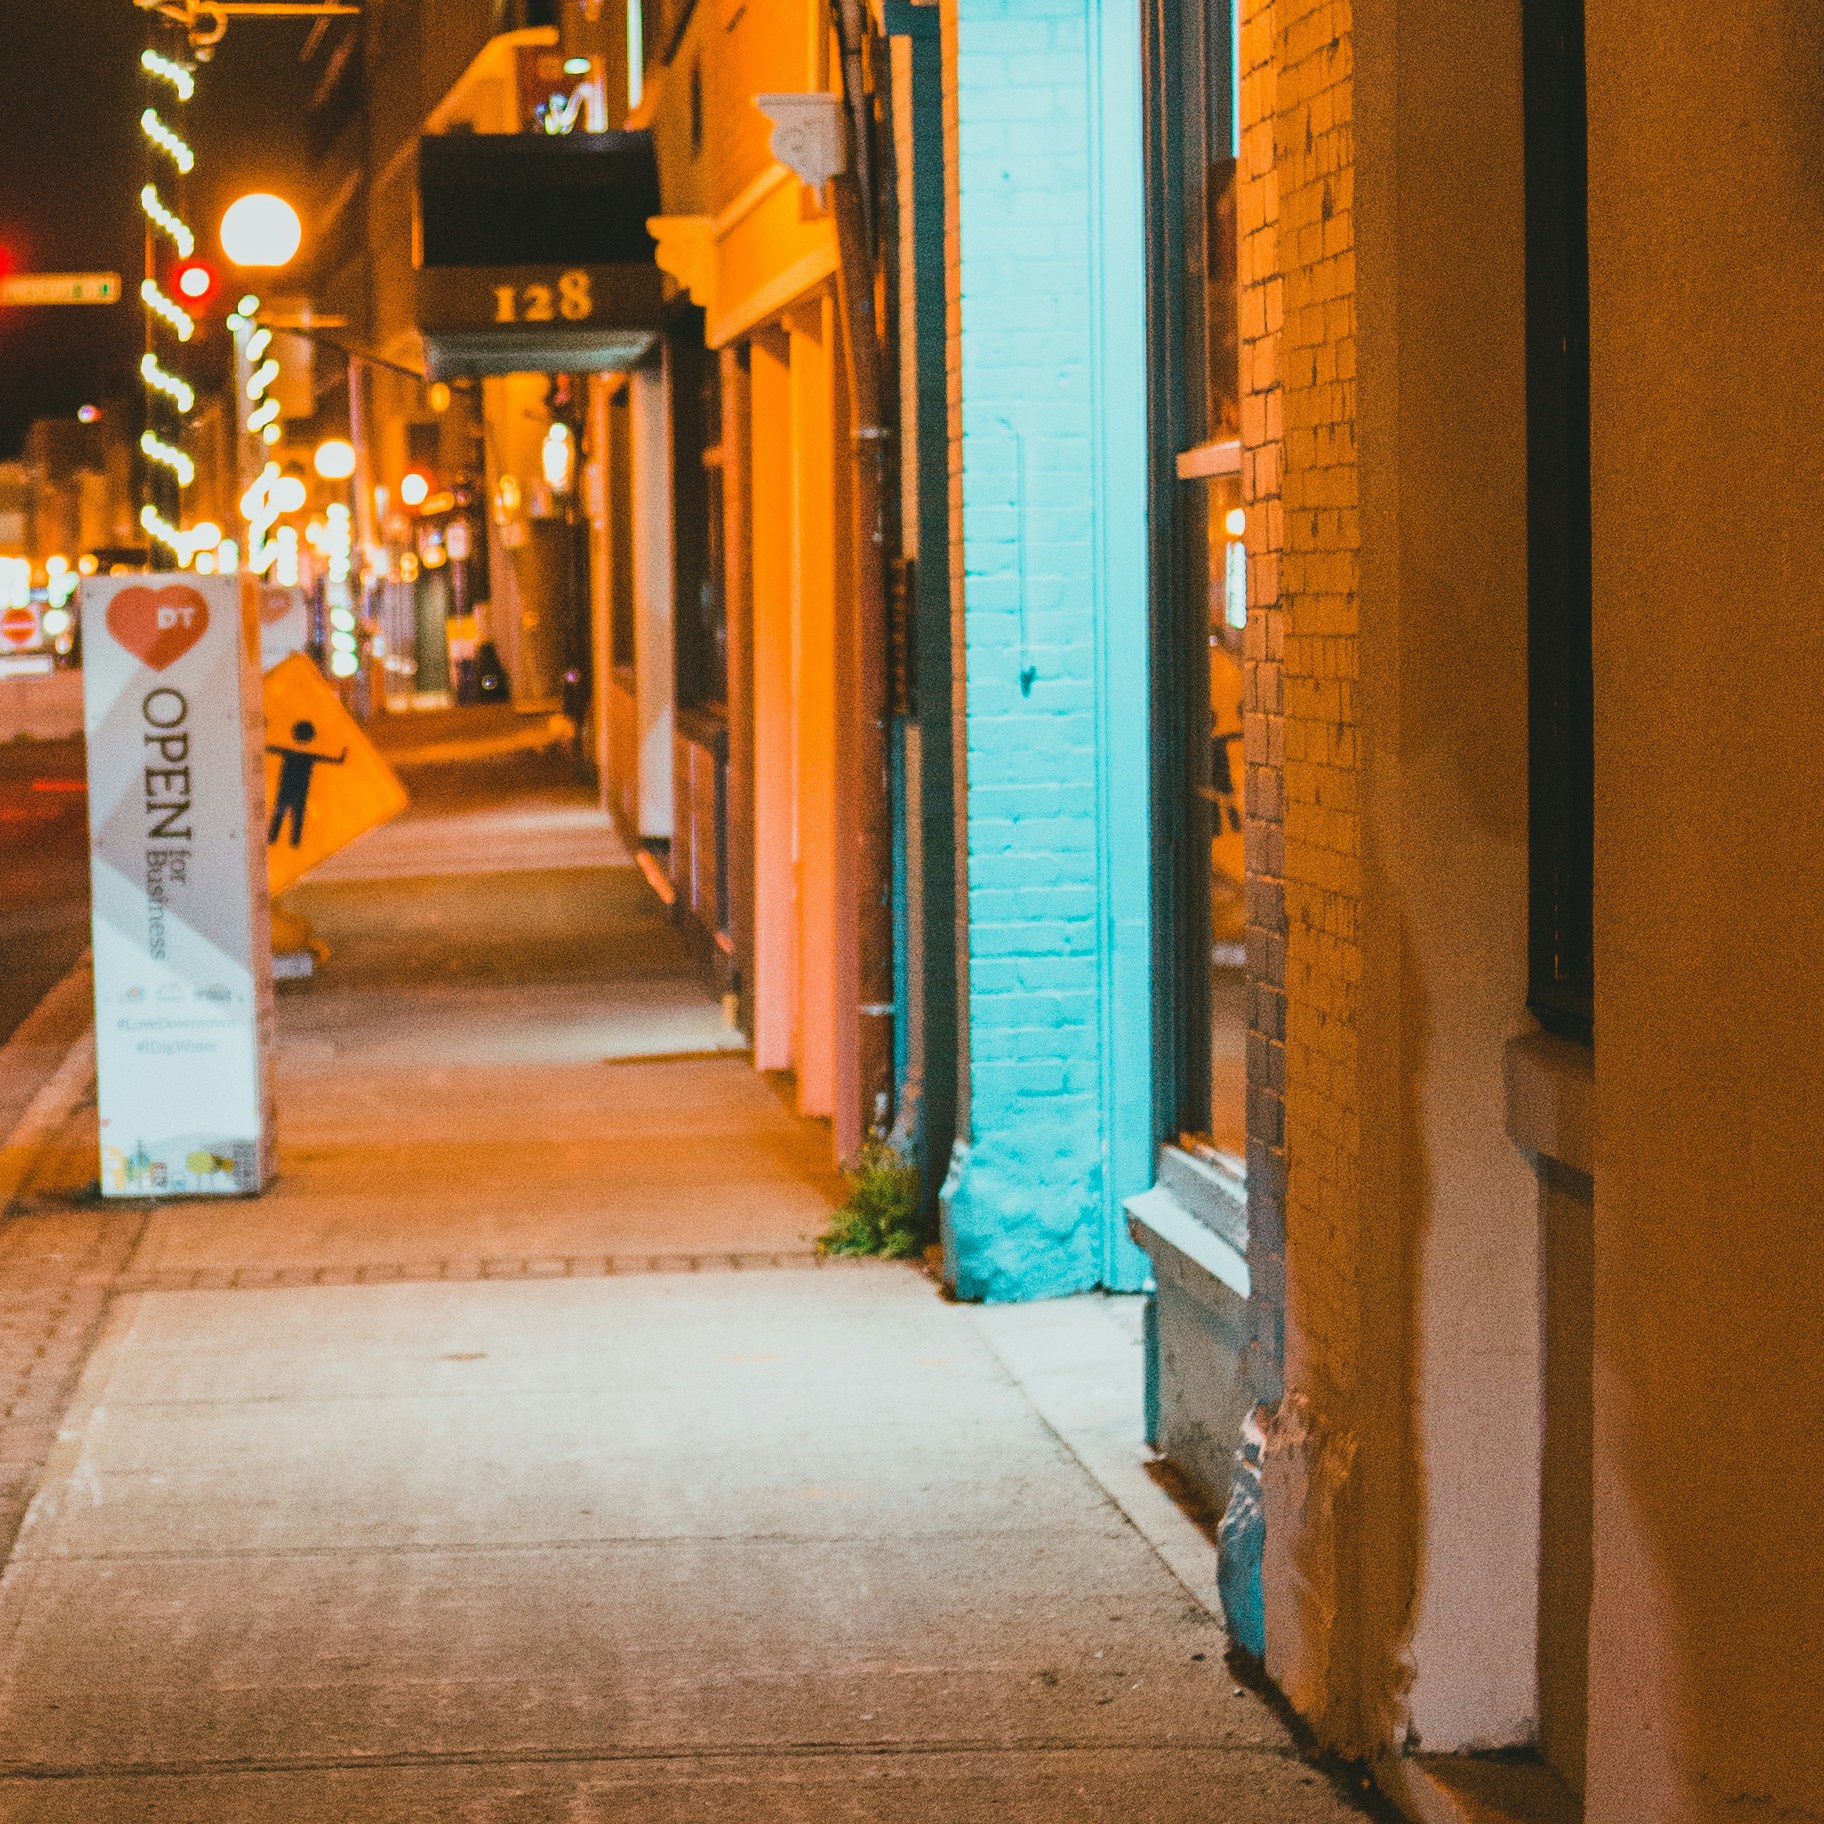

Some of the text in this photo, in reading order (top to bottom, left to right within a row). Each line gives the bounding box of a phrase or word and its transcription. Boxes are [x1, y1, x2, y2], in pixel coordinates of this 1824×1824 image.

[493, 269, 593, 323] 128
[157, 605, 196, 630] DT
[141, 686, 192, 842] OPEN
[168, 849, 192, 885] for
[144, 849, 167, 961] Business
